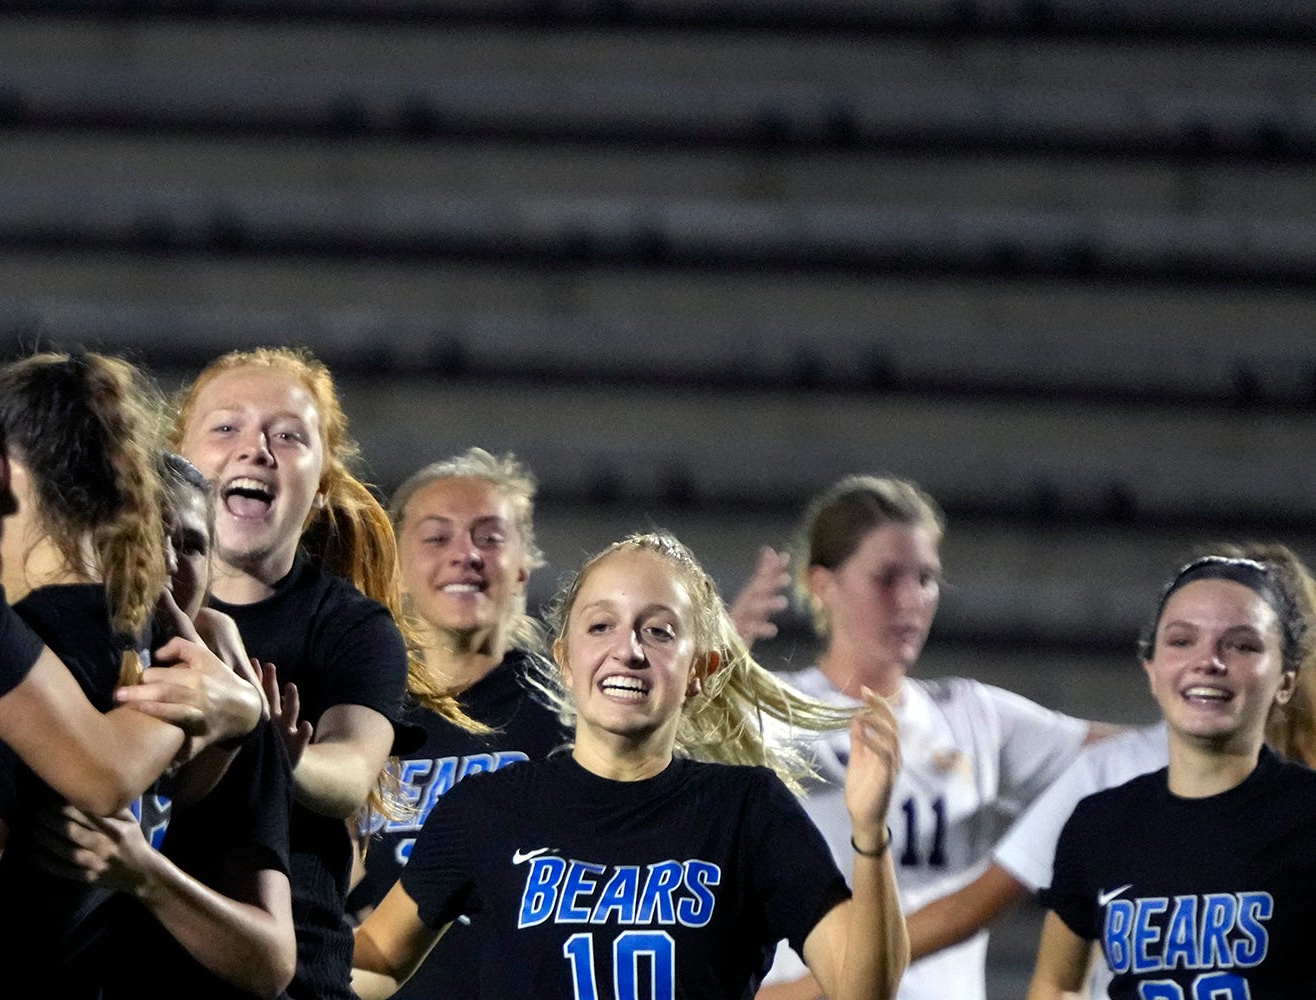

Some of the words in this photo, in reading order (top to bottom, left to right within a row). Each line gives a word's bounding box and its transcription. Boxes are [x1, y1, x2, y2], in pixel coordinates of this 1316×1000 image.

[900, 797, 947, 867] 11
[517, 856, 721, 929] BEARS
[1104, 891, 1274, 974] BEARS
